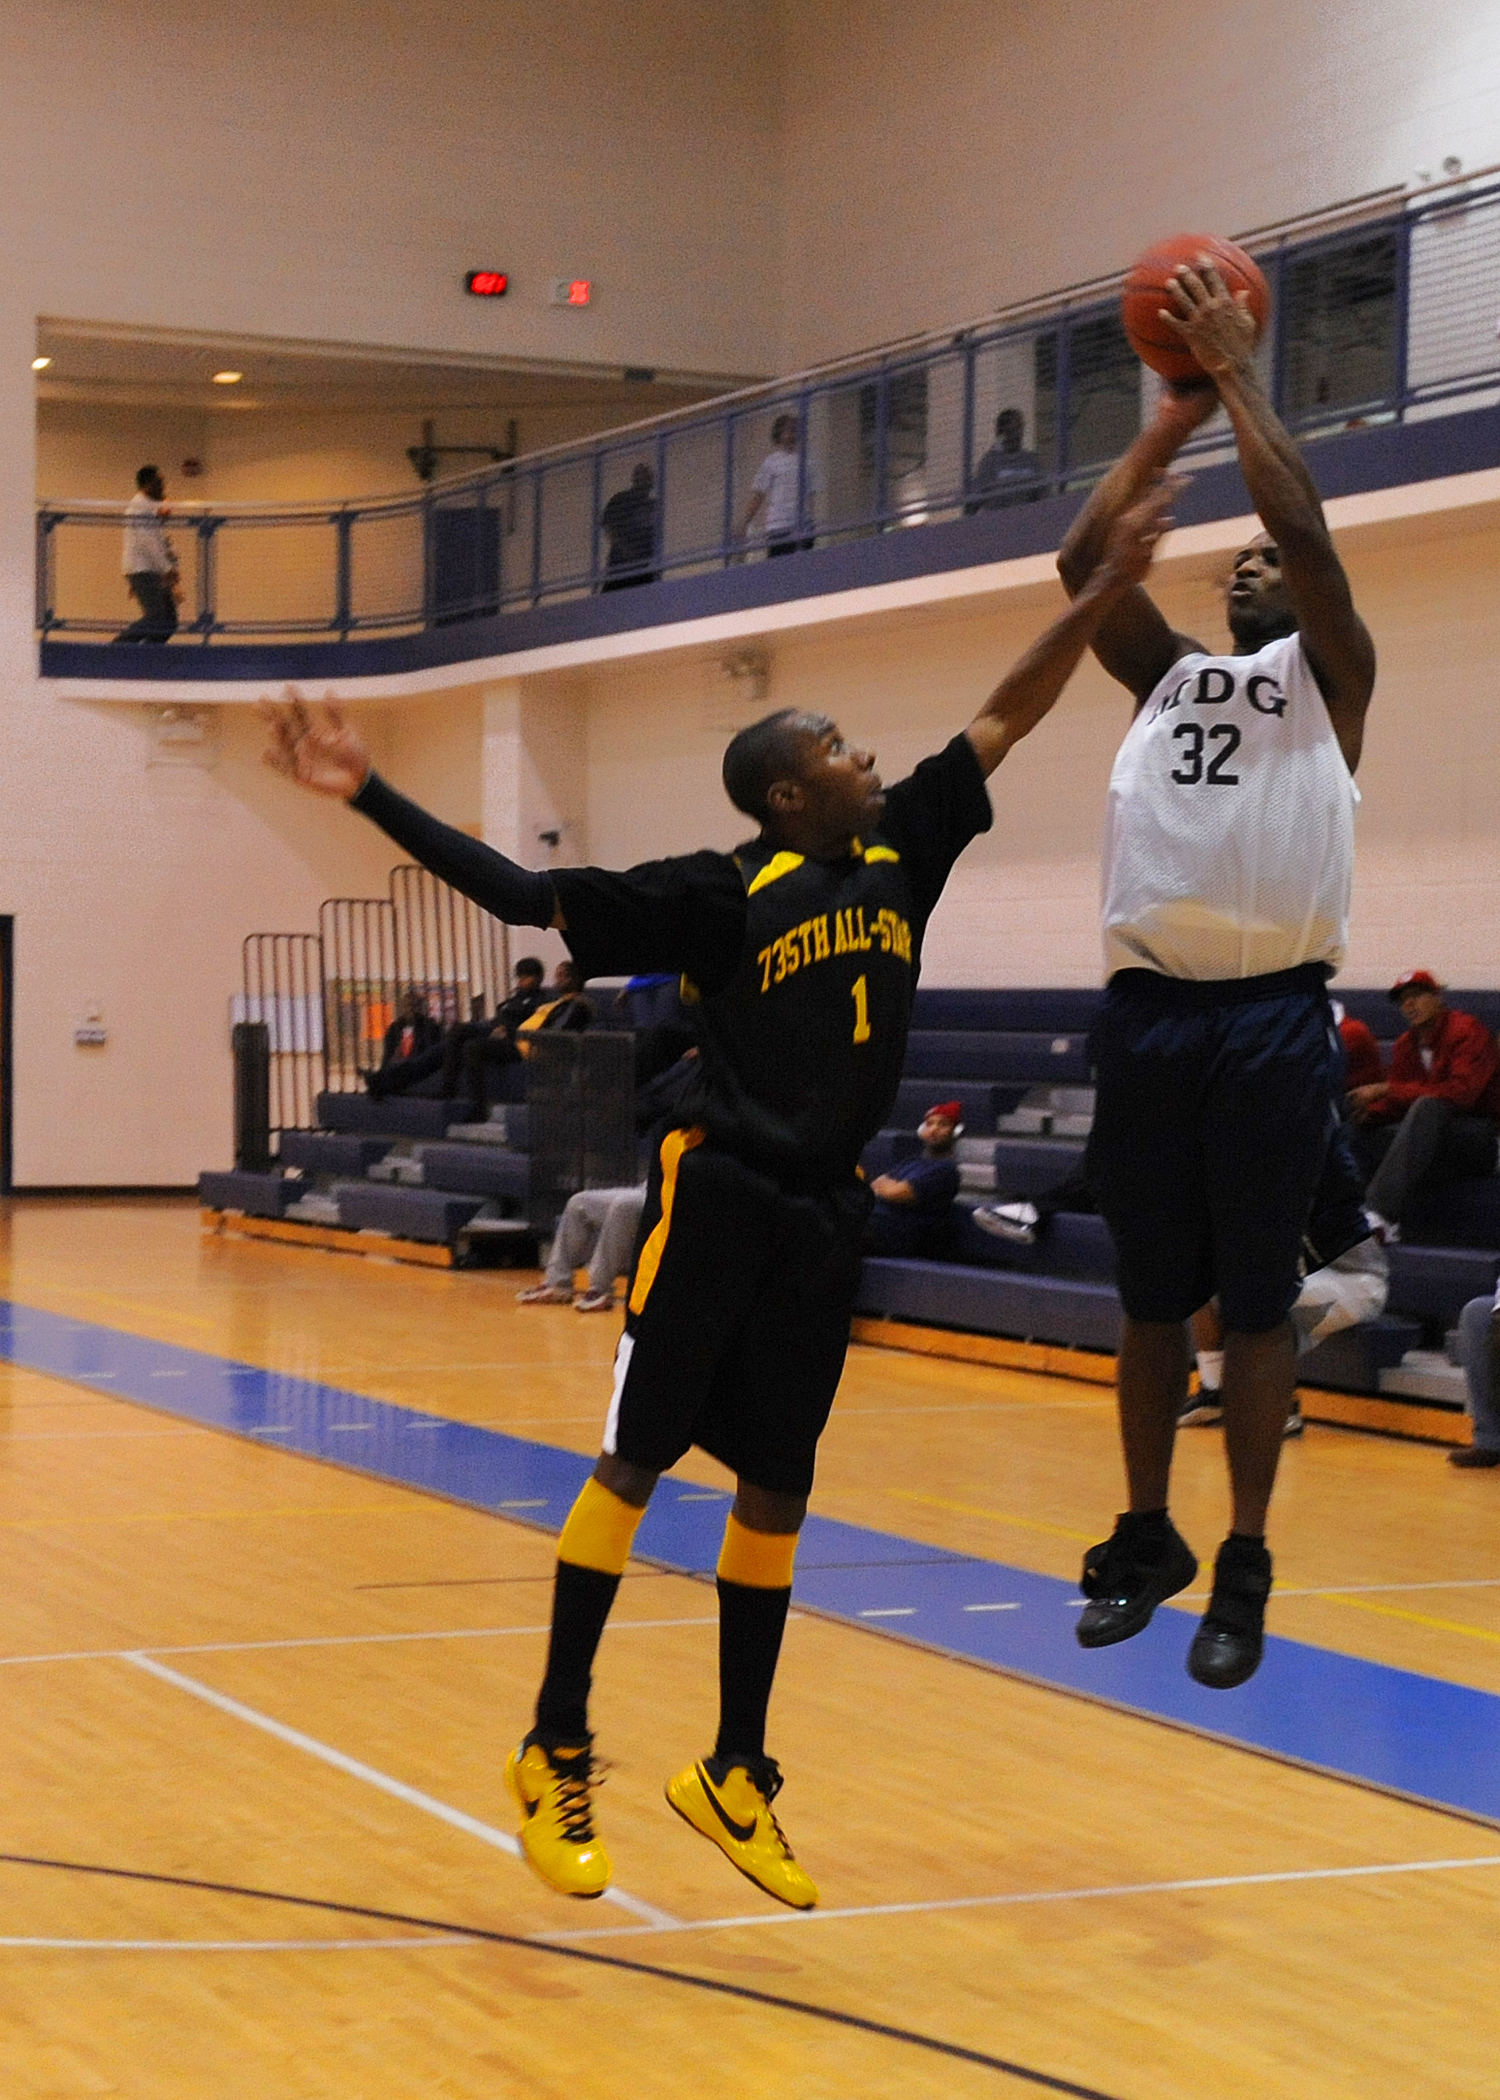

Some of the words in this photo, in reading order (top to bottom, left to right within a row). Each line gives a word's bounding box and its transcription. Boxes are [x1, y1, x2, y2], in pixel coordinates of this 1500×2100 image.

[1171, 722, 1242, 786] 32
[757, 912, 831, 995] 735TH
[851, 973, 872, 1045] 1
